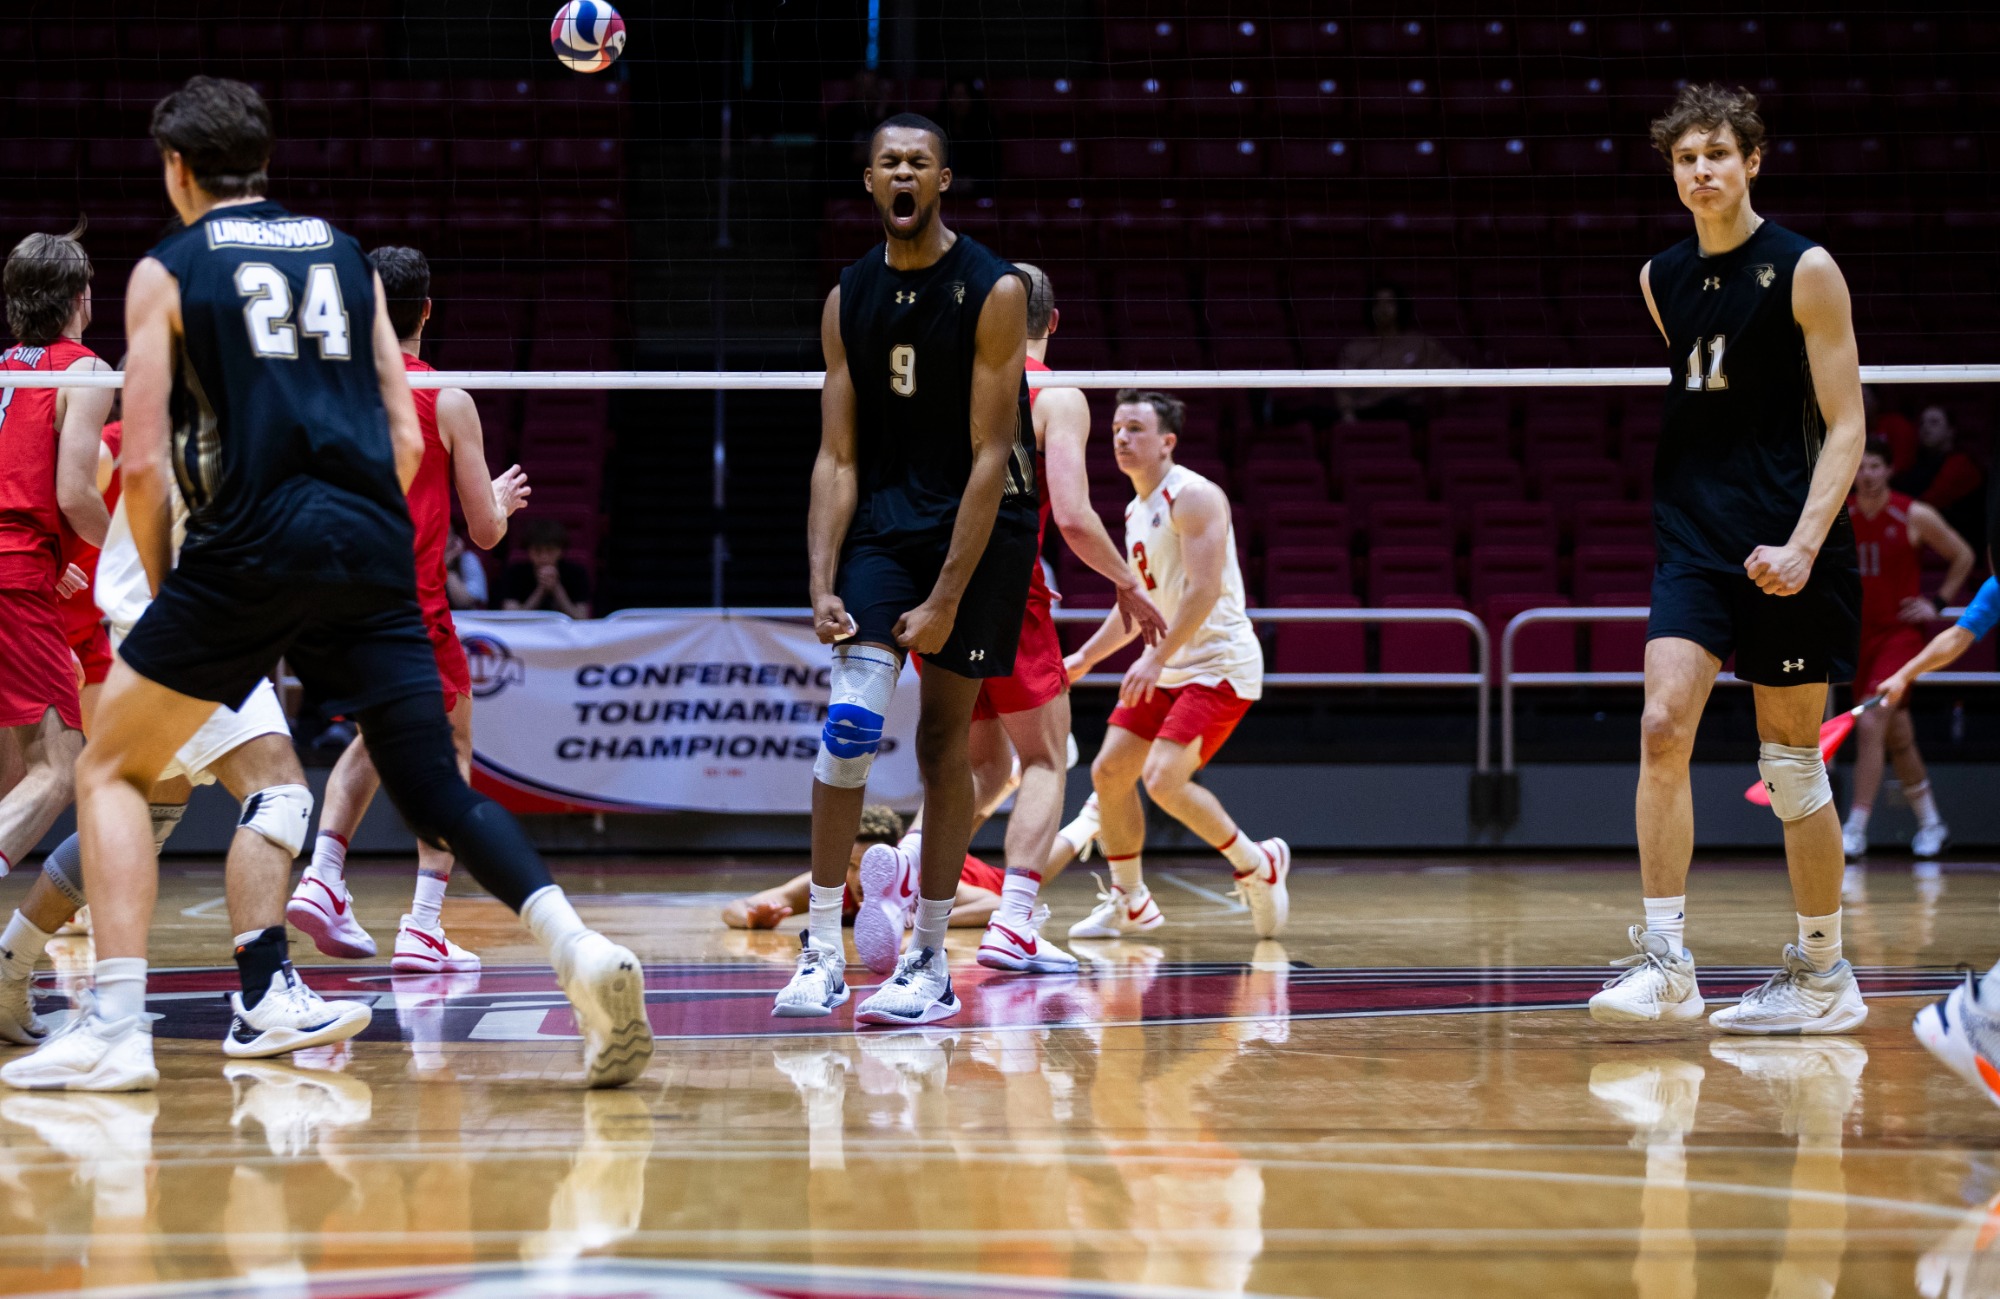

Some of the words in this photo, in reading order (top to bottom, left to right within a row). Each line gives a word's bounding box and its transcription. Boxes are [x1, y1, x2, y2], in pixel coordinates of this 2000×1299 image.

[206, 217, 334, 251] LINDENWOOD
[234, 262, 351, 359] 24
[890, 344, 917, 397] 9
[1686, 334, 1728, 391] 11
[1133, 541, 1157, 590] 2
[576, 664, 832, 687] CONFERENC
[557, 736, 897, 760] CHAMPIONSP
